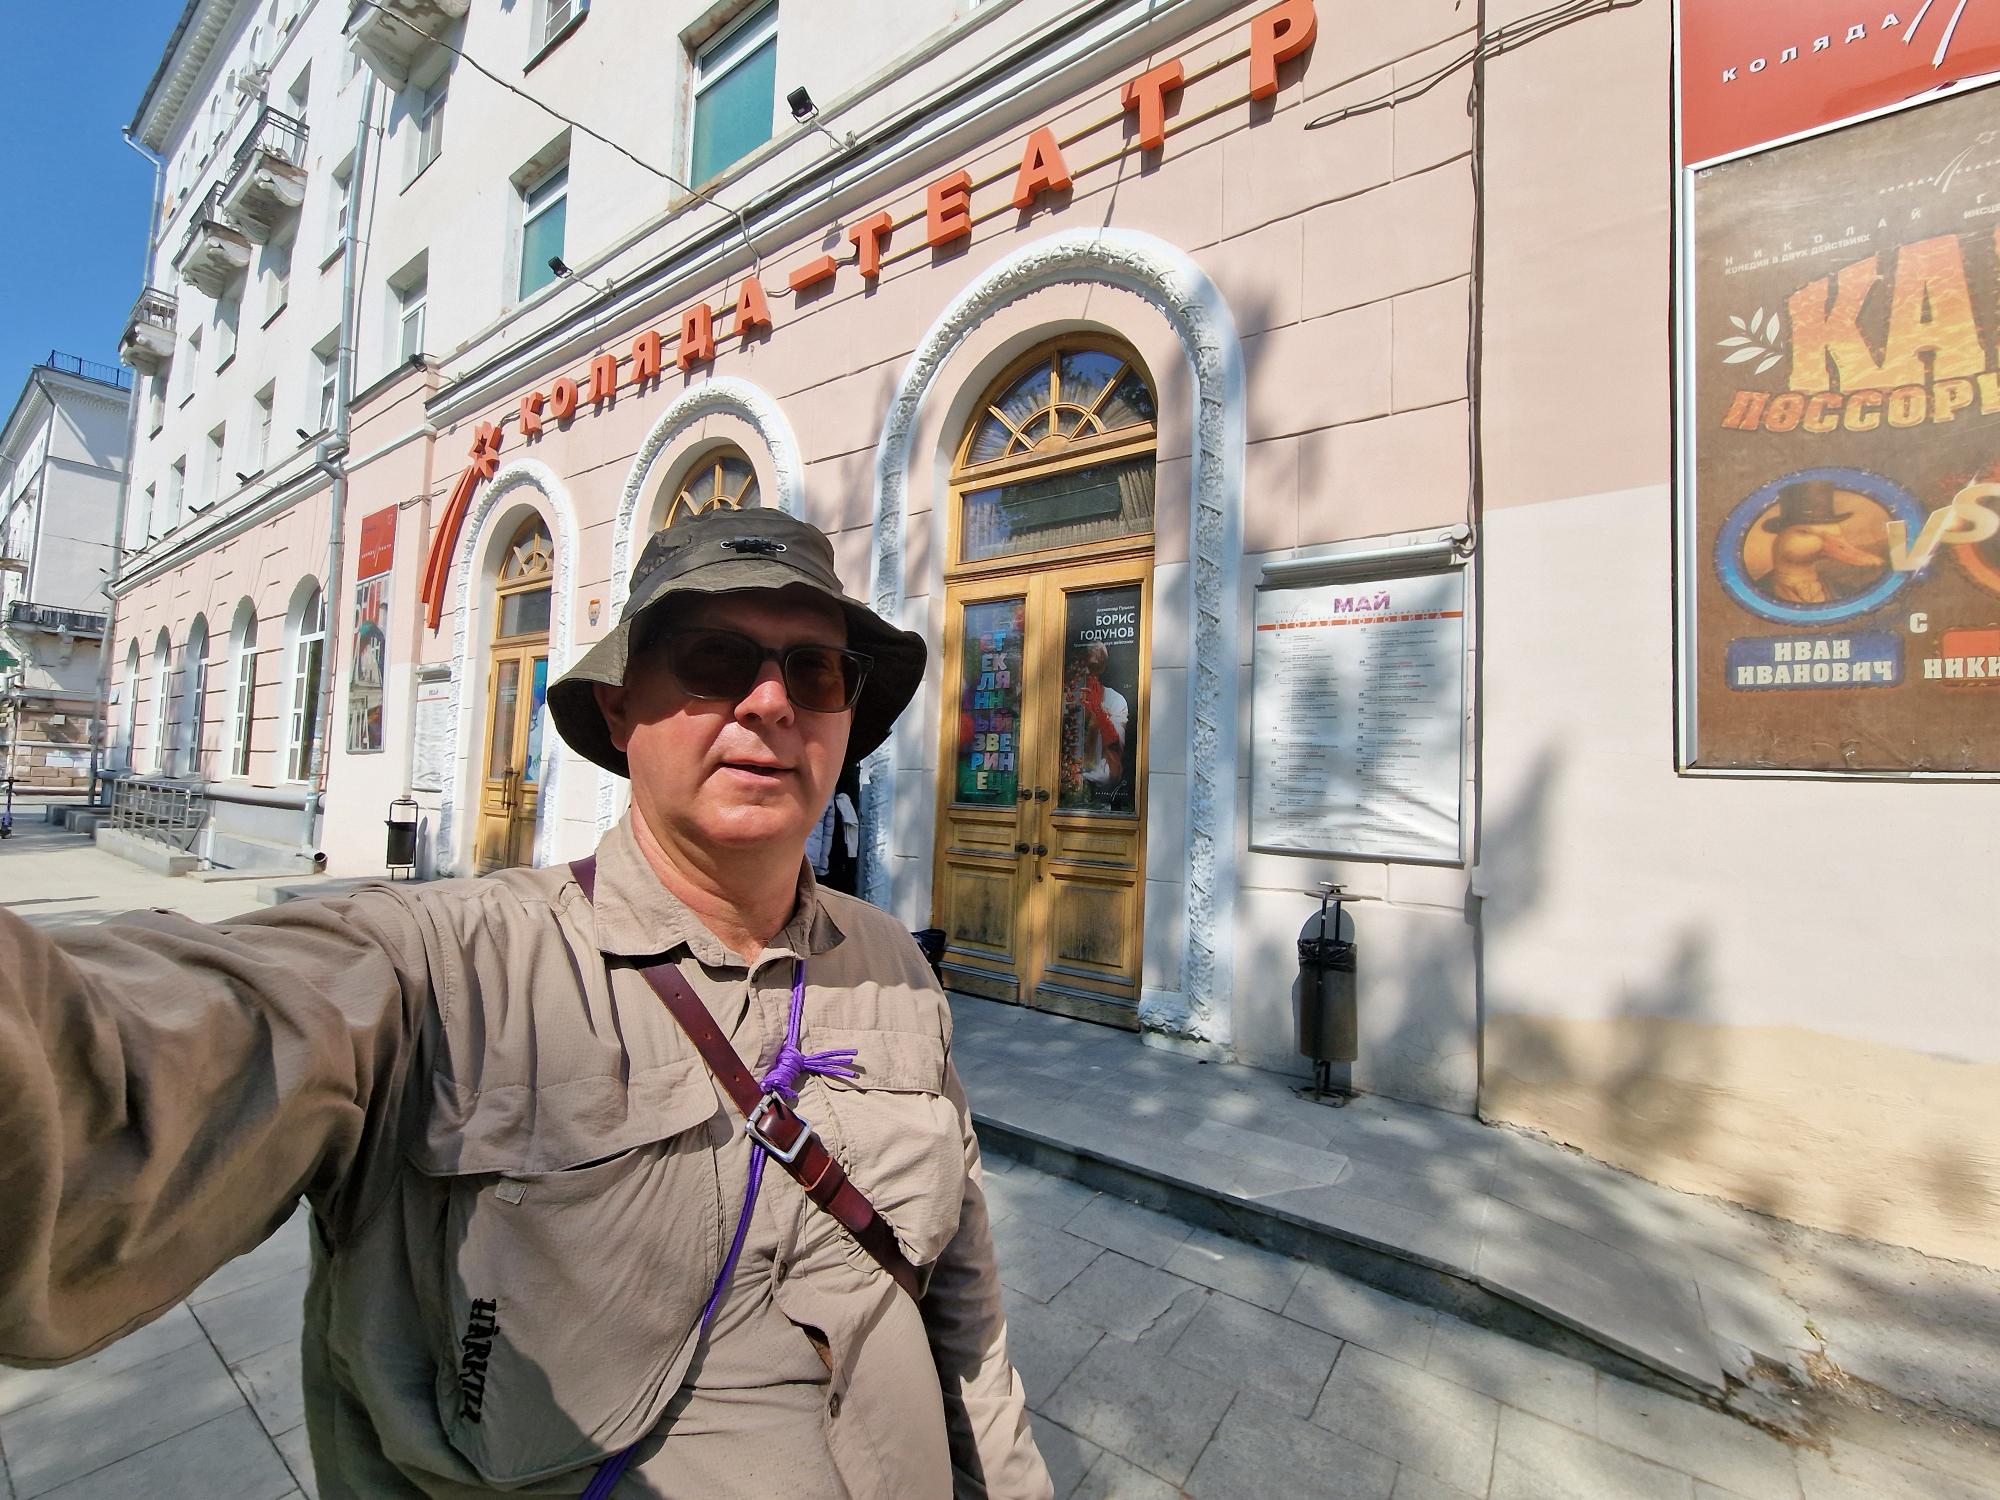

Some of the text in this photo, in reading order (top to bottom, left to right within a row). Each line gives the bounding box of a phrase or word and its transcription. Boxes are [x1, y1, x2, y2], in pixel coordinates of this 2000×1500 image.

[1722, 13, 1900, 83] КОЛЯДА
[1724, 258, 1769, 276] КОМЕДИЯ
[1772, 256, 1779, 264] В
[1782, 249, 1808, 263] ДВУХ
[1810, 234, 1871, 256] ДЕЙСТВИЯХ
[1788, 225, 2000, 392] КА
[1886, 482, 1999, 572] VS
[1333, 591, 1391, 614] МАЙ
[1096, 613, 1135, 626] БОРИС
[1080, 627, 1134, 641] ГОДУНОВ
[1774, 639, 1850, 662] ИВАН
[981, 653, 1007, 672] ЕК
[1737, 661, 1892, 685] ИВАНОВИЧ
[976, 671, 1010, 690] ЛЯ
[973, 733, 1012, 752] ЗВЕ
[970, 752, 1015, 771] РИН
